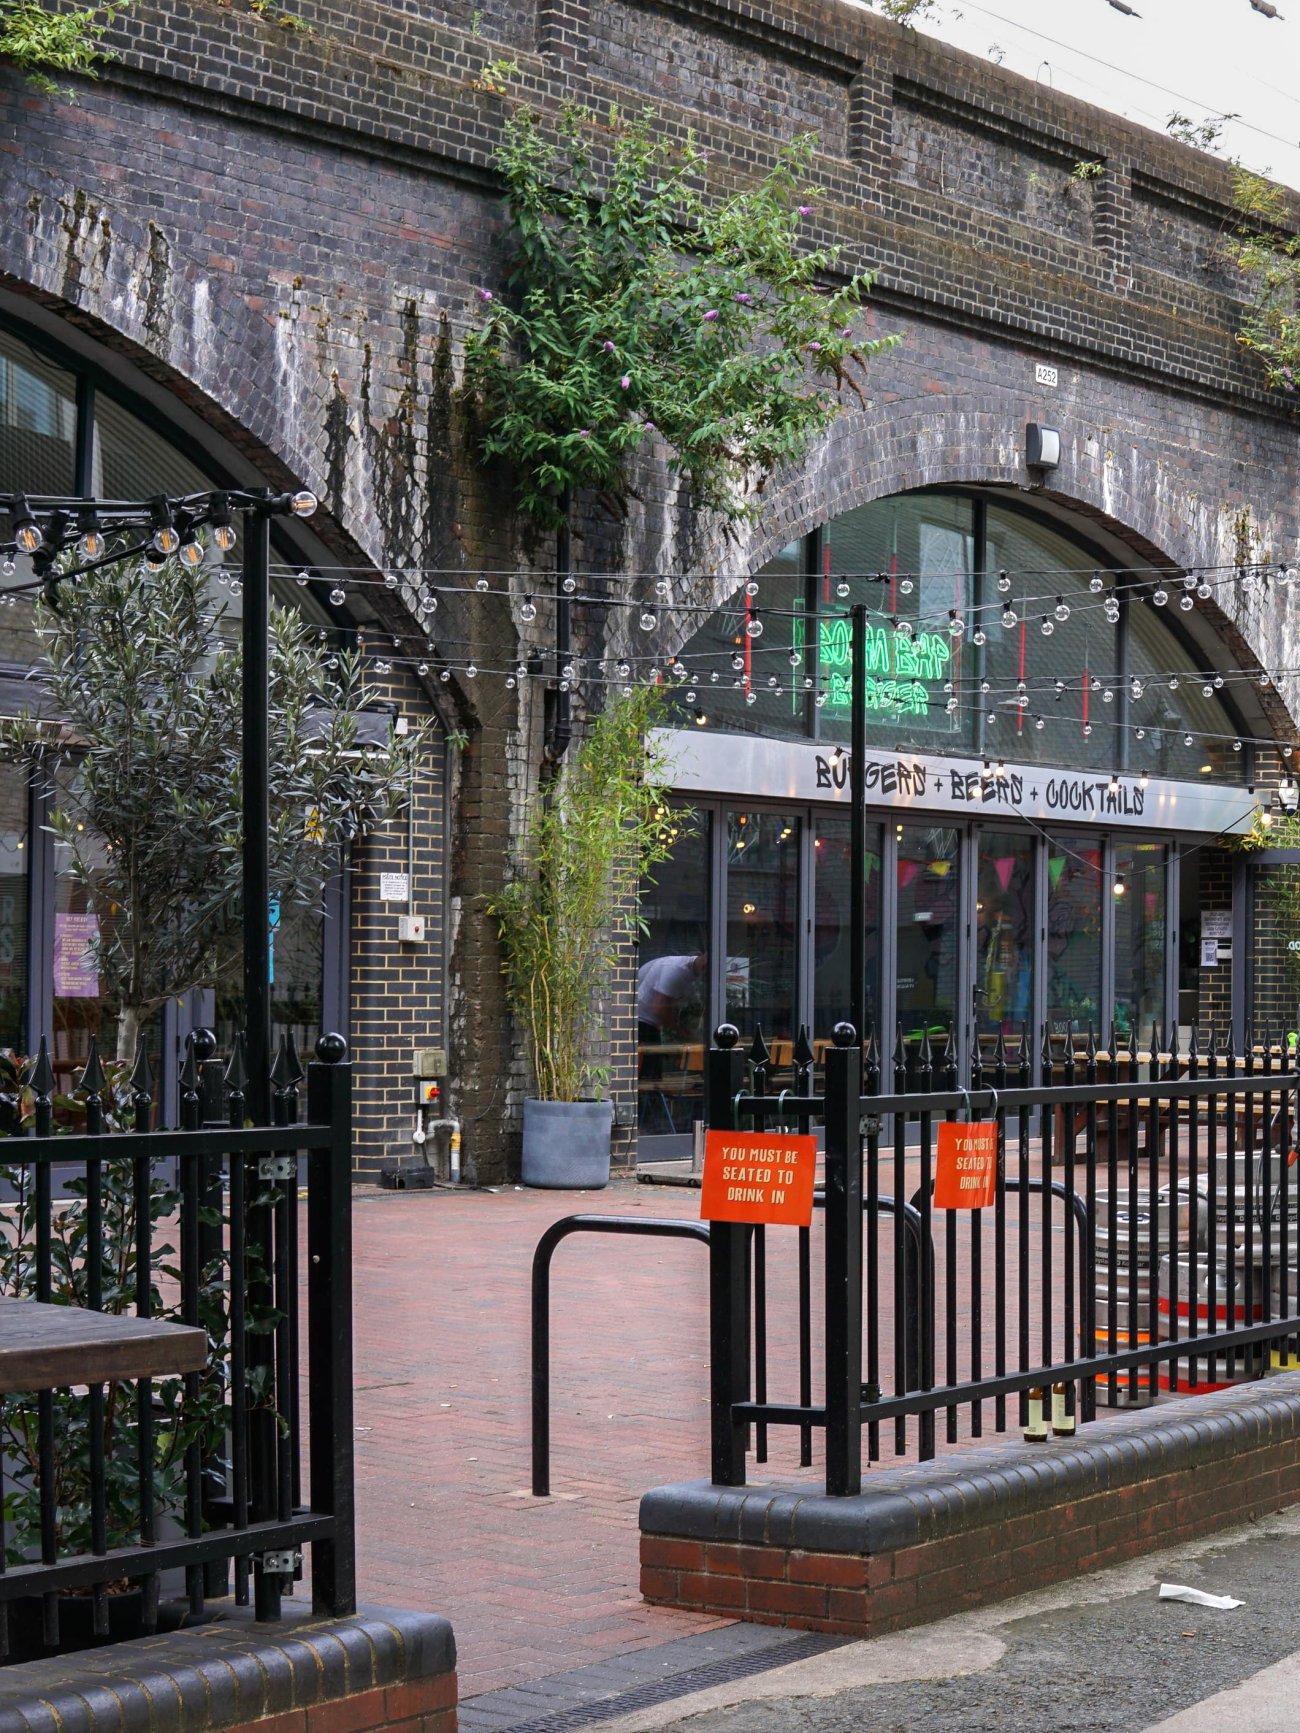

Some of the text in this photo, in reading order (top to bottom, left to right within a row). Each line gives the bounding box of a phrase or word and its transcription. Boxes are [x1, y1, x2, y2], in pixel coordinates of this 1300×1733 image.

[1037, 367, 1057, 384] A252
[815, 755, 927, 797] BUGERS
[950, 769, 1023, 805] BEERS
[1046, 778, 1145, 816] COCKTAILS
[954, 1138, 973, 1152] YOU
[722, 1147, 799, 1164] YOU MUST BE
[956, 1156, 985, 1170] SEATED
[722, 1166, 794, 1185] SEATED TO
[727, 1186, 785, 1205] DRINK IN
